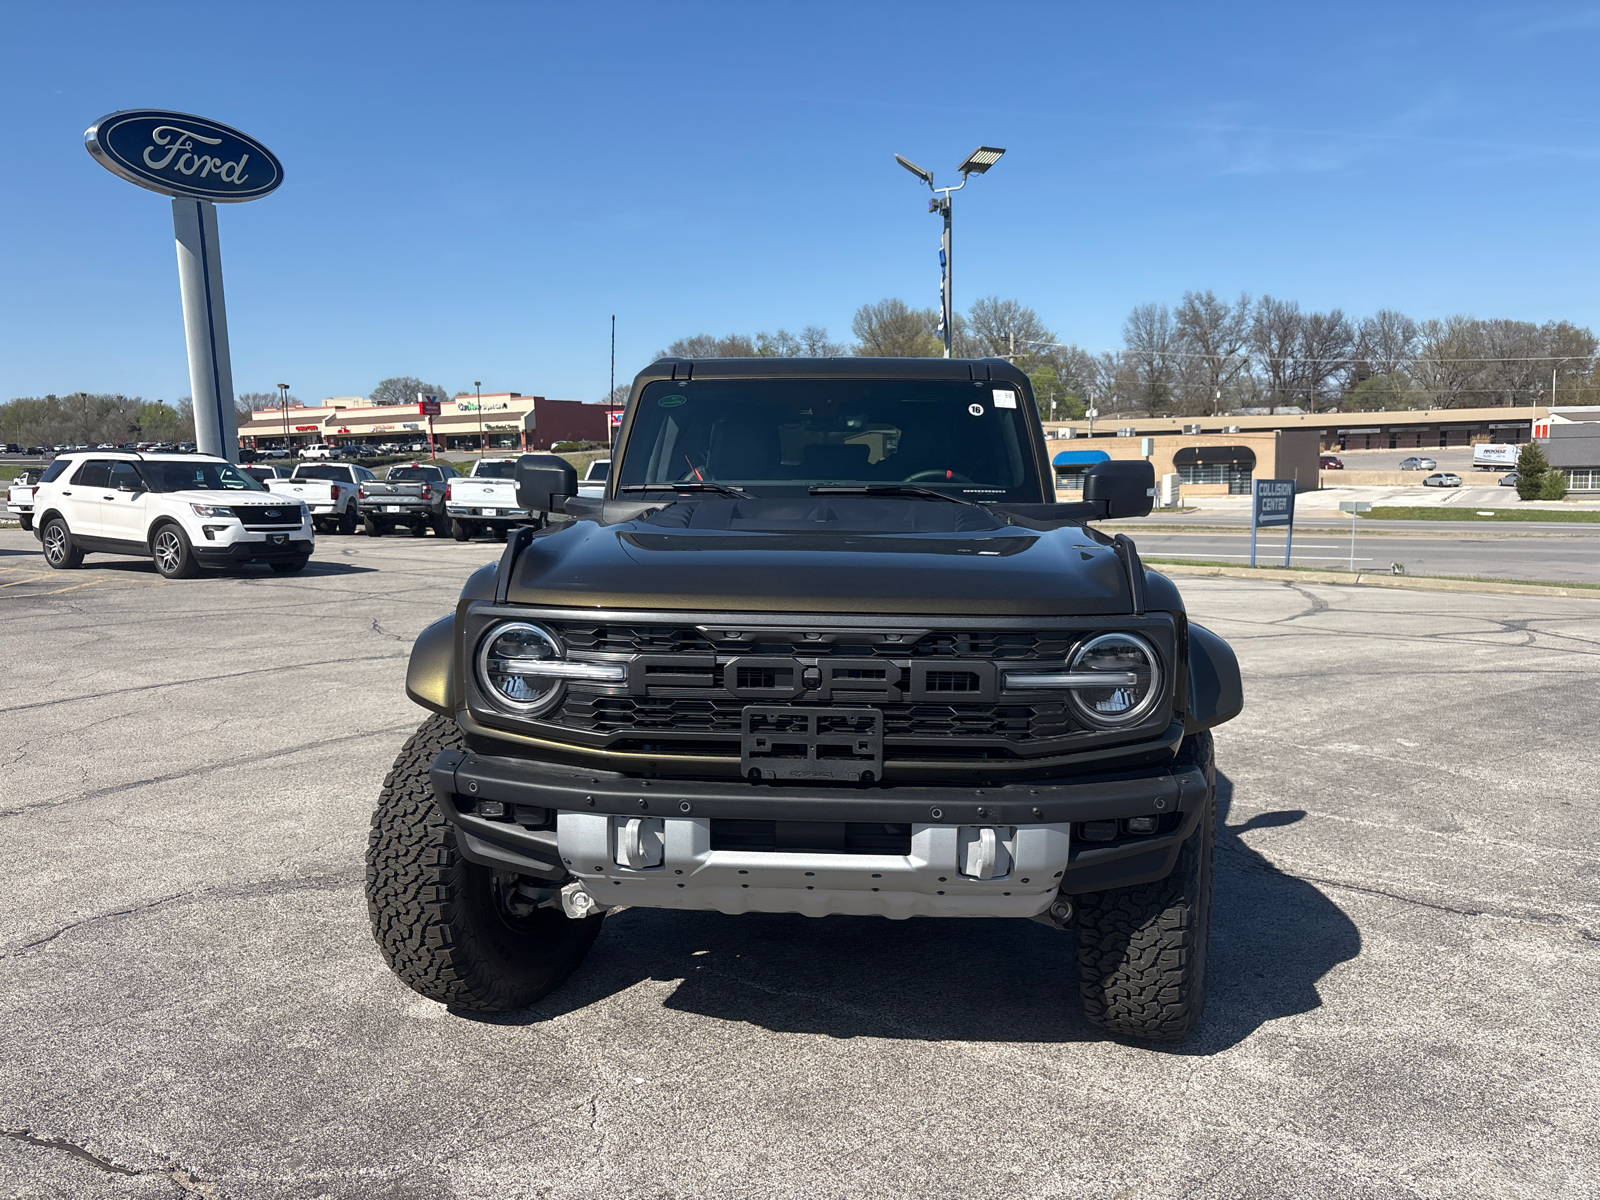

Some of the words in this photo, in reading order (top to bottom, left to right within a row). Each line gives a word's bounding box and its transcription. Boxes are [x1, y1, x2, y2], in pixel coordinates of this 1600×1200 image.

[143, 126, 250, 185] Ford
[971, 405, 982, 414] 16
[1258, 483, 1292, 497] COLLISION
[1262, 498, 1287, 511] CENTER
[628, 653, 1000, 702] FORD
